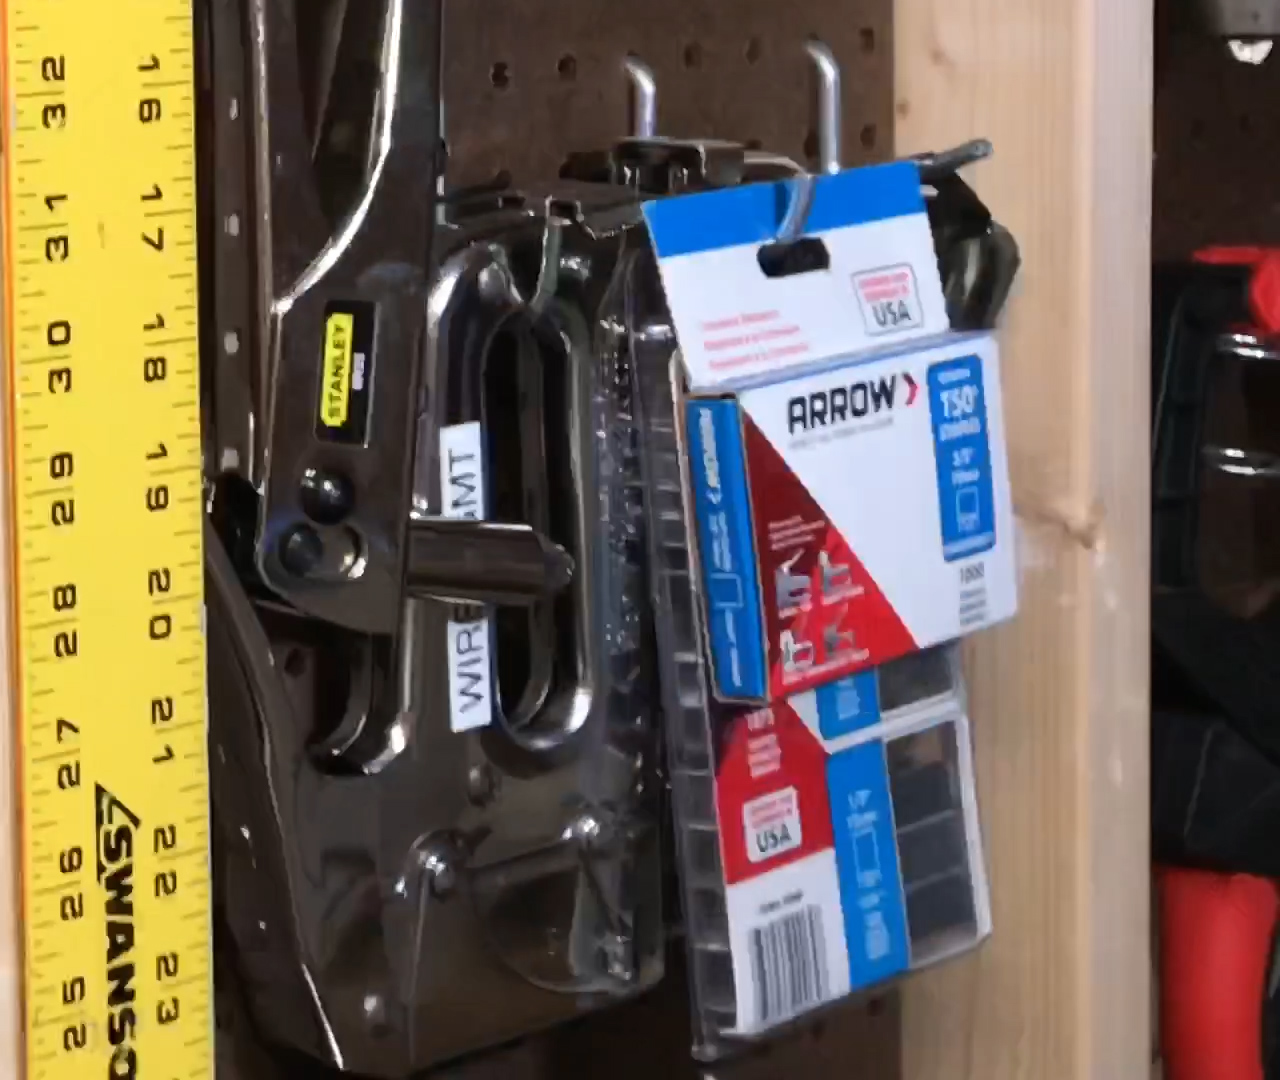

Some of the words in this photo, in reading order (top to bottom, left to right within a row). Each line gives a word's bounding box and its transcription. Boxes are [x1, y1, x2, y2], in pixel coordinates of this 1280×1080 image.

[42, 54, 66, 130] 32
[136, 53, 161, 125] 16
[44, 194, 69, 262] 31
[140, 183, 164, 252] 17
[143, 313, 167, 383] 18
[872, 300, 912, 327] USA
[47, 320, 72, 394] 30
[327, 323, 346, 419] STANLEY
[787, 372, 896, 436] ARROW
[49, 451, 75, 526] 29
[145, 442, 169, 512] 19
[53, 583, 78, 657] 28
[148, 567, 172, 640] 20
[56, 717, 80, 789] 27
[151, 696, 175, 765] 21
[153, 824, 177, 899] 22
[756, 825, 793, 854] USA
[59, 846, 84, 921] 26
[62, 976, 86, 1052] 25
[156, 952, 179, 1025] 23
